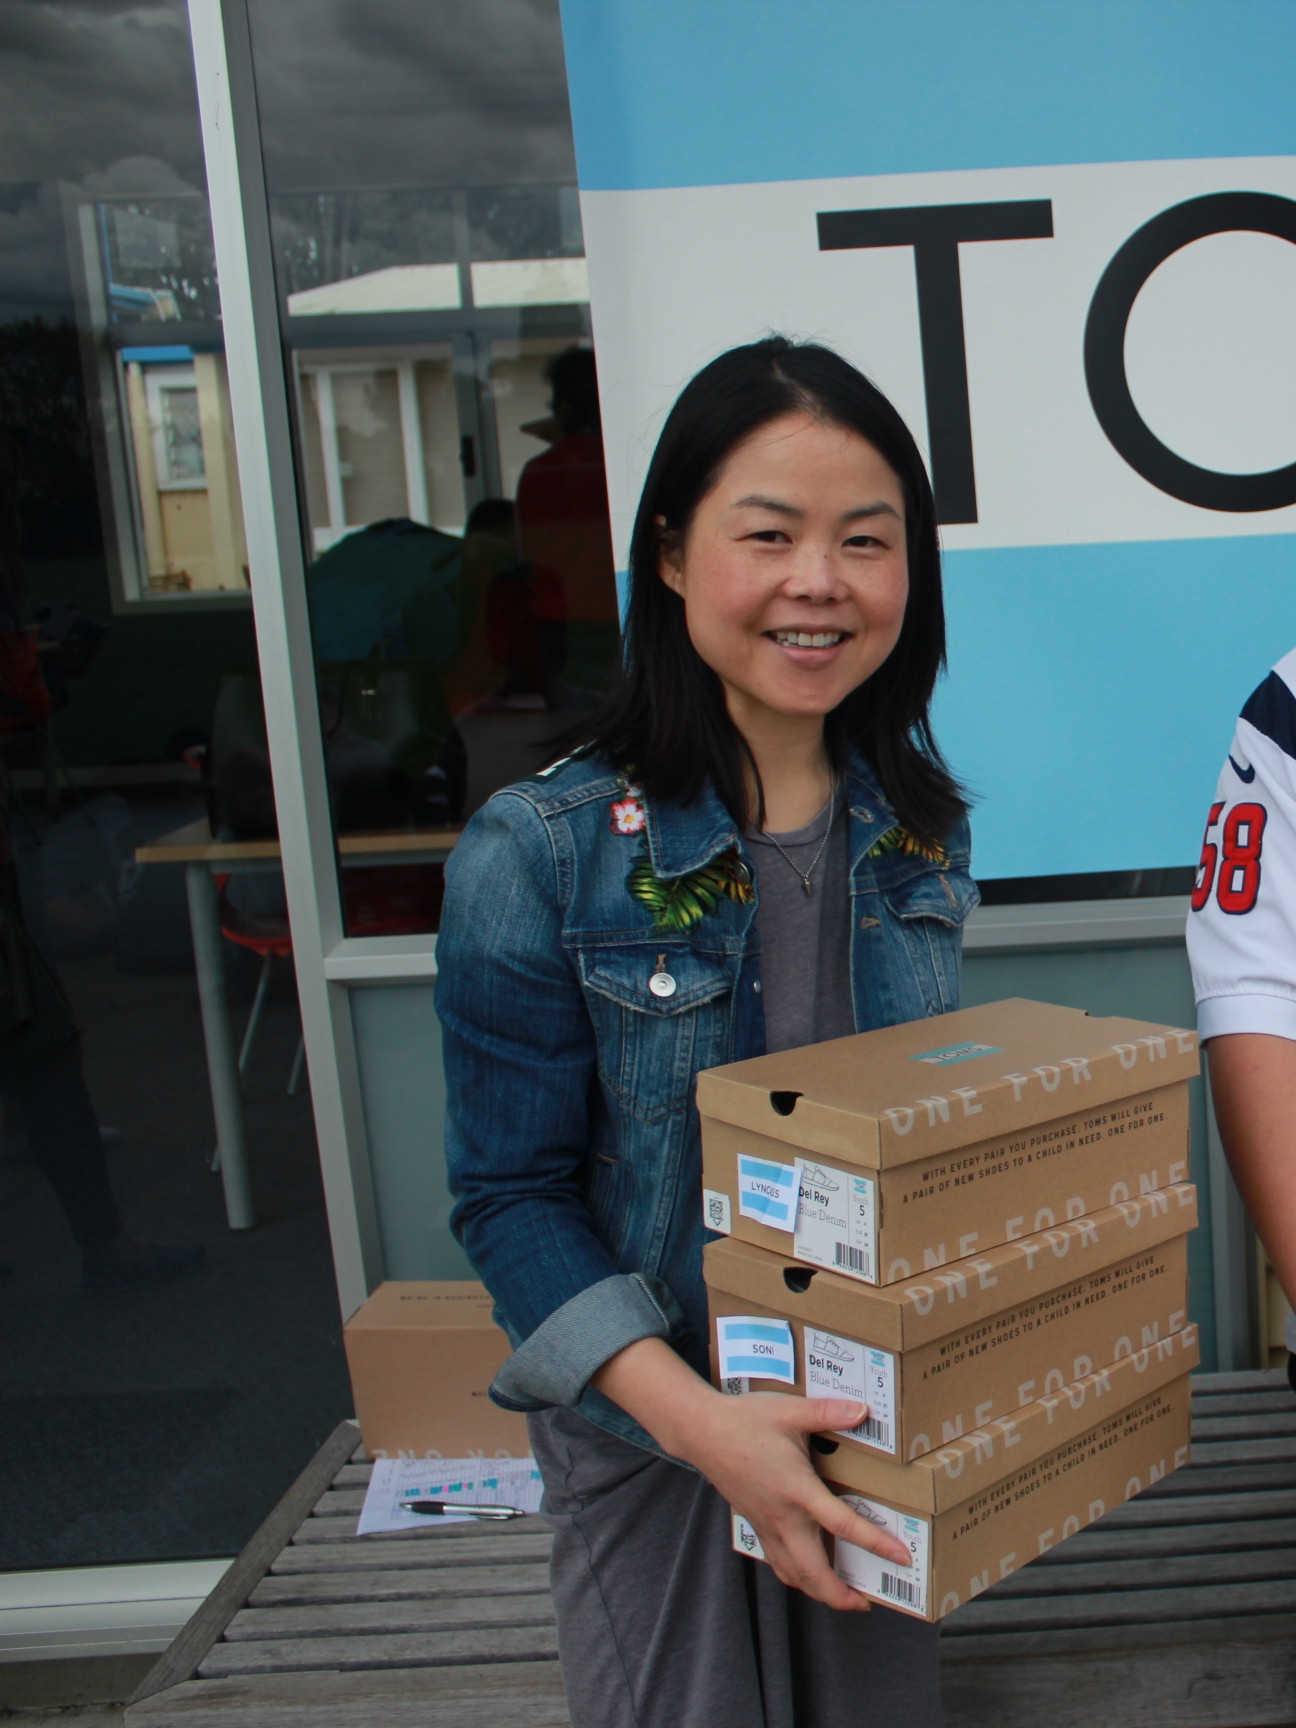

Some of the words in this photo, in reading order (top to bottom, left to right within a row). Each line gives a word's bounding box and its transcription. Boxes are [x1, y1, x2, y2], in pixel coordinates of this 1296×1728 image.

[1192, 802, 1267, 915] 58
[884, 1086, 983, 1135] ONE
[1002, 1057, 1092, 1102] FOR
[1111, 1028, 1194, 1069] ONE
[922, 1166, 945, 1182] WITH
[950, 1155, 980, 1174] EVERY
[984, 1148, 1005, 1163] PAIR
[1009, 1141, 1026, 1156] YOU
[1084, 1116, 1107, 1133] TOMS
[1110, 1109, 1130, 1125] WILL
[1133, 1102, 1153, 1118] GIVE
[902, 1193, 908, 1204] A
[912, 1185, 934, 1201] PAIR
[938, 1180, 950, 1193] OF
[954, 1173, 974, 1188] NEW
[978, 1162, 1009, 1180] SHOES
[1013, 1157, 1023, 1169] TO
[1026, 1155, 1032, 1165] A
[1035, 1145, 1062, 1162] CHILD
[1065, 1141, 1074, 1153] IN
[1107, 1126, 1124, 1140] ONE
[1128, 1120, 1144, 1133] FOR
[799, 1186, 812, 1198] Del
[814, 1190, 829, 1206] Rey
[799, 1202, 816, 1219] Blue
[819, 1210, 847, 1229] Denim
[860, 1205, 865, 1216] 5
[904, 1258, 998, 1316] ONE
[1013, 1219, 1098, 1270] FOR
[1115, 1185, 1194, 1228] ONE
[939, 1338, 960, 1356] WITH
[964, 1324, 992, 1345] EVERY
[995, 1314, 1016, 1332] PAIR
[1018, 1306, 1035, 1322] YOU
[1089, 1273, 1111, 1292] TOMS
[1114, 1264, 1133, 1282] WILL
[1135, 1255, 1154, 1272] GIVE
[922, 1369, 927, 1380] A
[931, 1359, 950, 1376] PAIR
[953, 1353, 964, 1366] OF
[968, 1343, 987, 1360] NEW
[991, 1329, 1020, 1350] SHOES
[1023, 1324, 1033, 1336] TO
[1036, 1320, 1041, 1331] A
[1044, 1308, 1069, 1327] CHILD
[1072, 1303, 1081, 1315] IN
[1112, 1283, 1128, 1298] ONE
[1130, 1275, 1146, 1290] FOR
[752, 1344, 774, 1355] SONI
[809, 1354, 824, 1368] Del
[827, 1359, 844, 1376] Rey
[869, 1365, 888, 1378] Youth
[810, 1370, 830, 1387] Blue
[833, 1378, 863, 1399] Denim
[877, 1376, 884, 1387] 5
[935, 1414, 1021, 1479] ONE
[1036, 1368, 1111, 1424] FOR
[1131, 1325, 1196, 1373] ONE
[903, 1530, 922, 1543] Youth
[911, 1541, 917, 1552] 5
